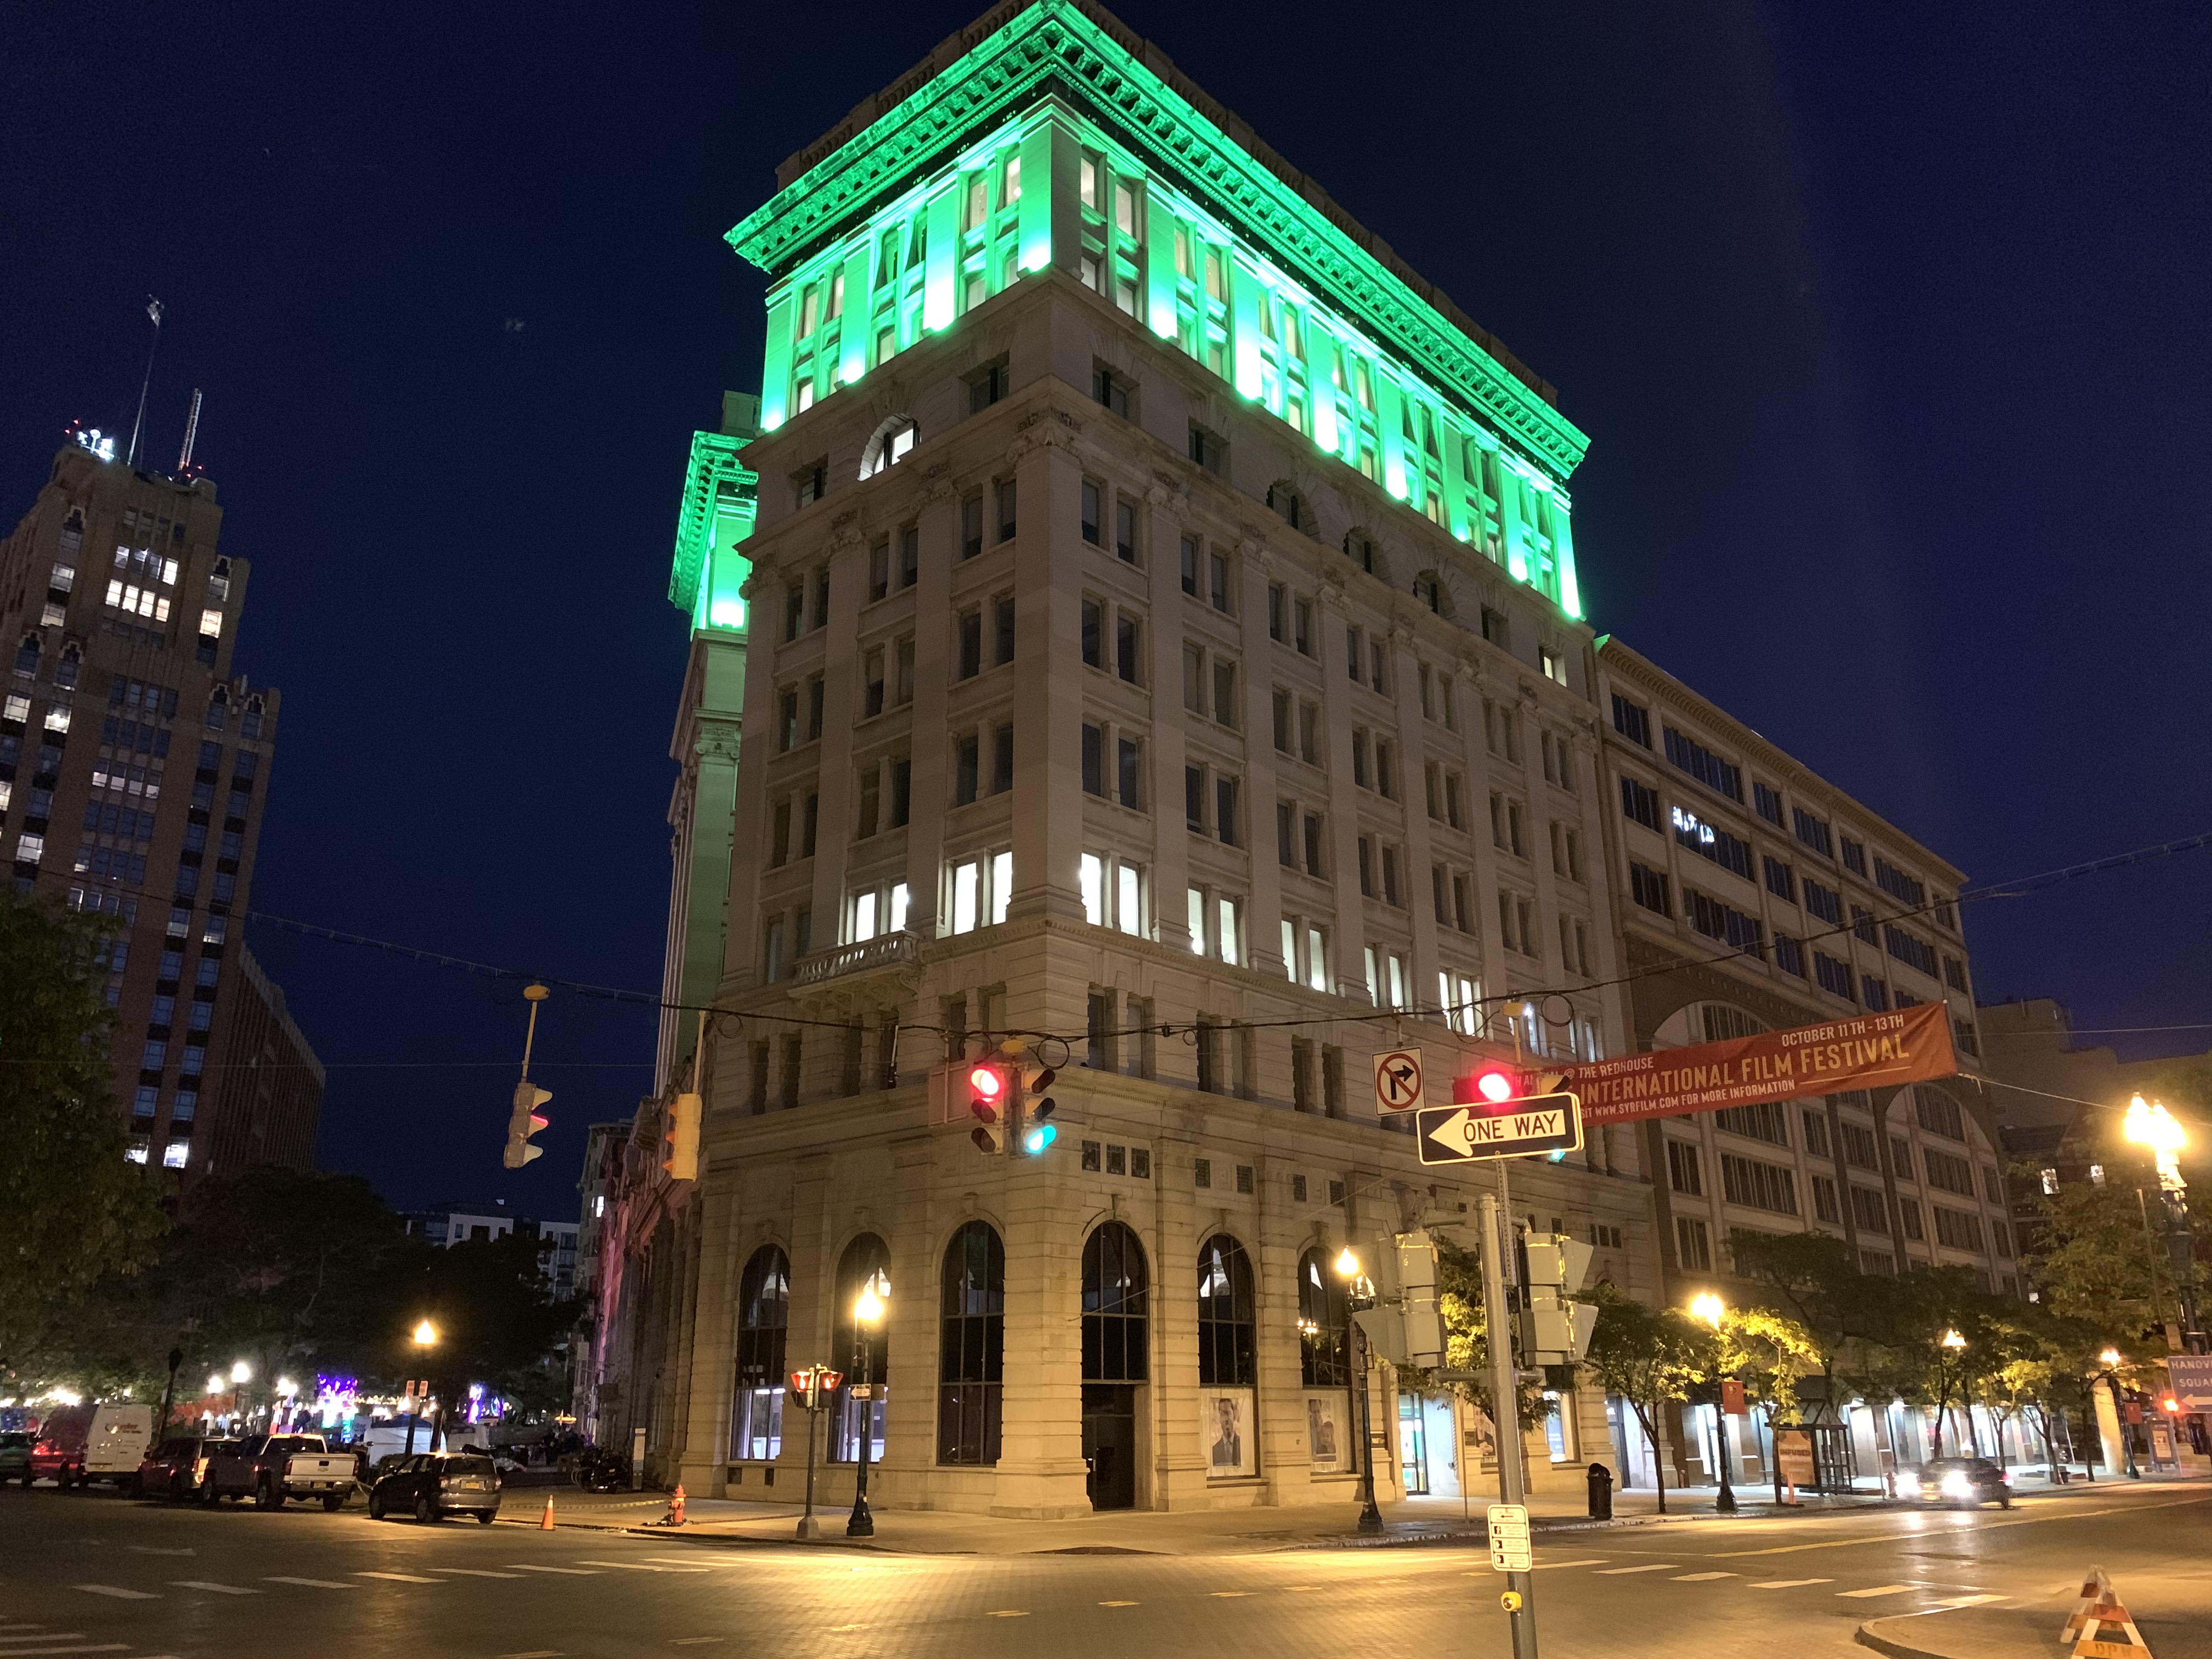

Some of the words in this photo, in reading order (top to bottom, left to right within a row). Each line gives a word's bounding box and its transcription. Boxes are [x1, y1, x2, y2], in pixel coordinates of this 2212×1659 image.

[1782, 1026, 1835, 1047] OCTOBER
[1875, 1014, 1904, 1031] 13TH
[1578, 1066, 1598, 1079] THE
[1600, 1057, 1654, 1077] REDHOUSE
[1581, 1063, 1734, 1105] INTERNATIONAL
[1741, 1052, 1793, 1082] FILM
[1800, 1034, 1909, 1073] FESTIVAL
[1595, 1096, 1679, 1117] WWW.SYRFILM.COM
[1681, 1093, 1699, 1105] FOR
[1701, 1088, 1728, 1103] MORE
[1730, 1079, 1795, 1099] INFORMATION
[1464, 1119, 1504, 1142] ONE
[1514, 1113, 1557, 1136] WAY
[2171, 1361, 2212, 1369] HANOV
